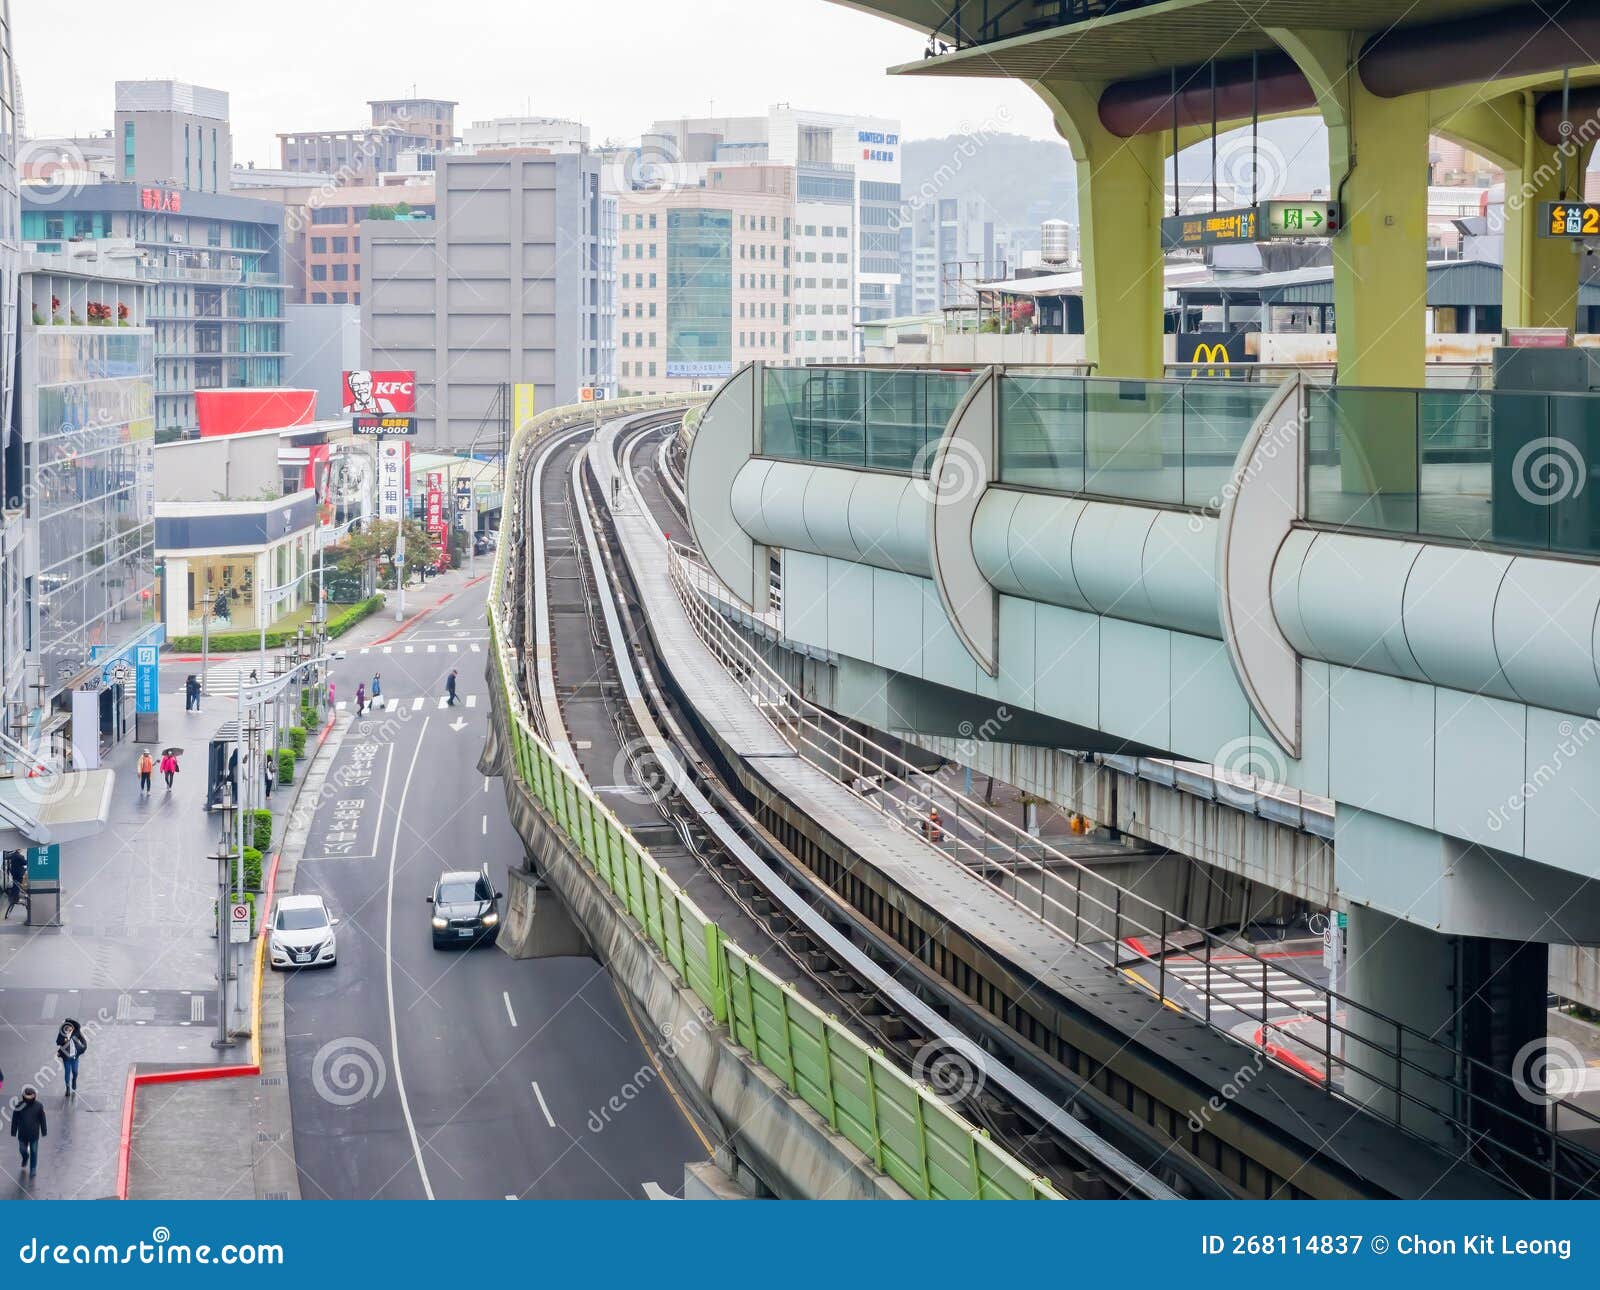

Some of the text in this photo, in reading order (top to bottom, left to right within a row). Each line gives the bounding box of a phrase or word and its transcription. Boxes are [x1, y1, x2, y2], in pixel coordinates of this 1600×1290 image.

[1582, 207, 1599, 233] 2
[375, 382, 413, 395] KFC
[358, 426, 408, 434] 4128-000
[385, 462, 397, 515] 格上租車
